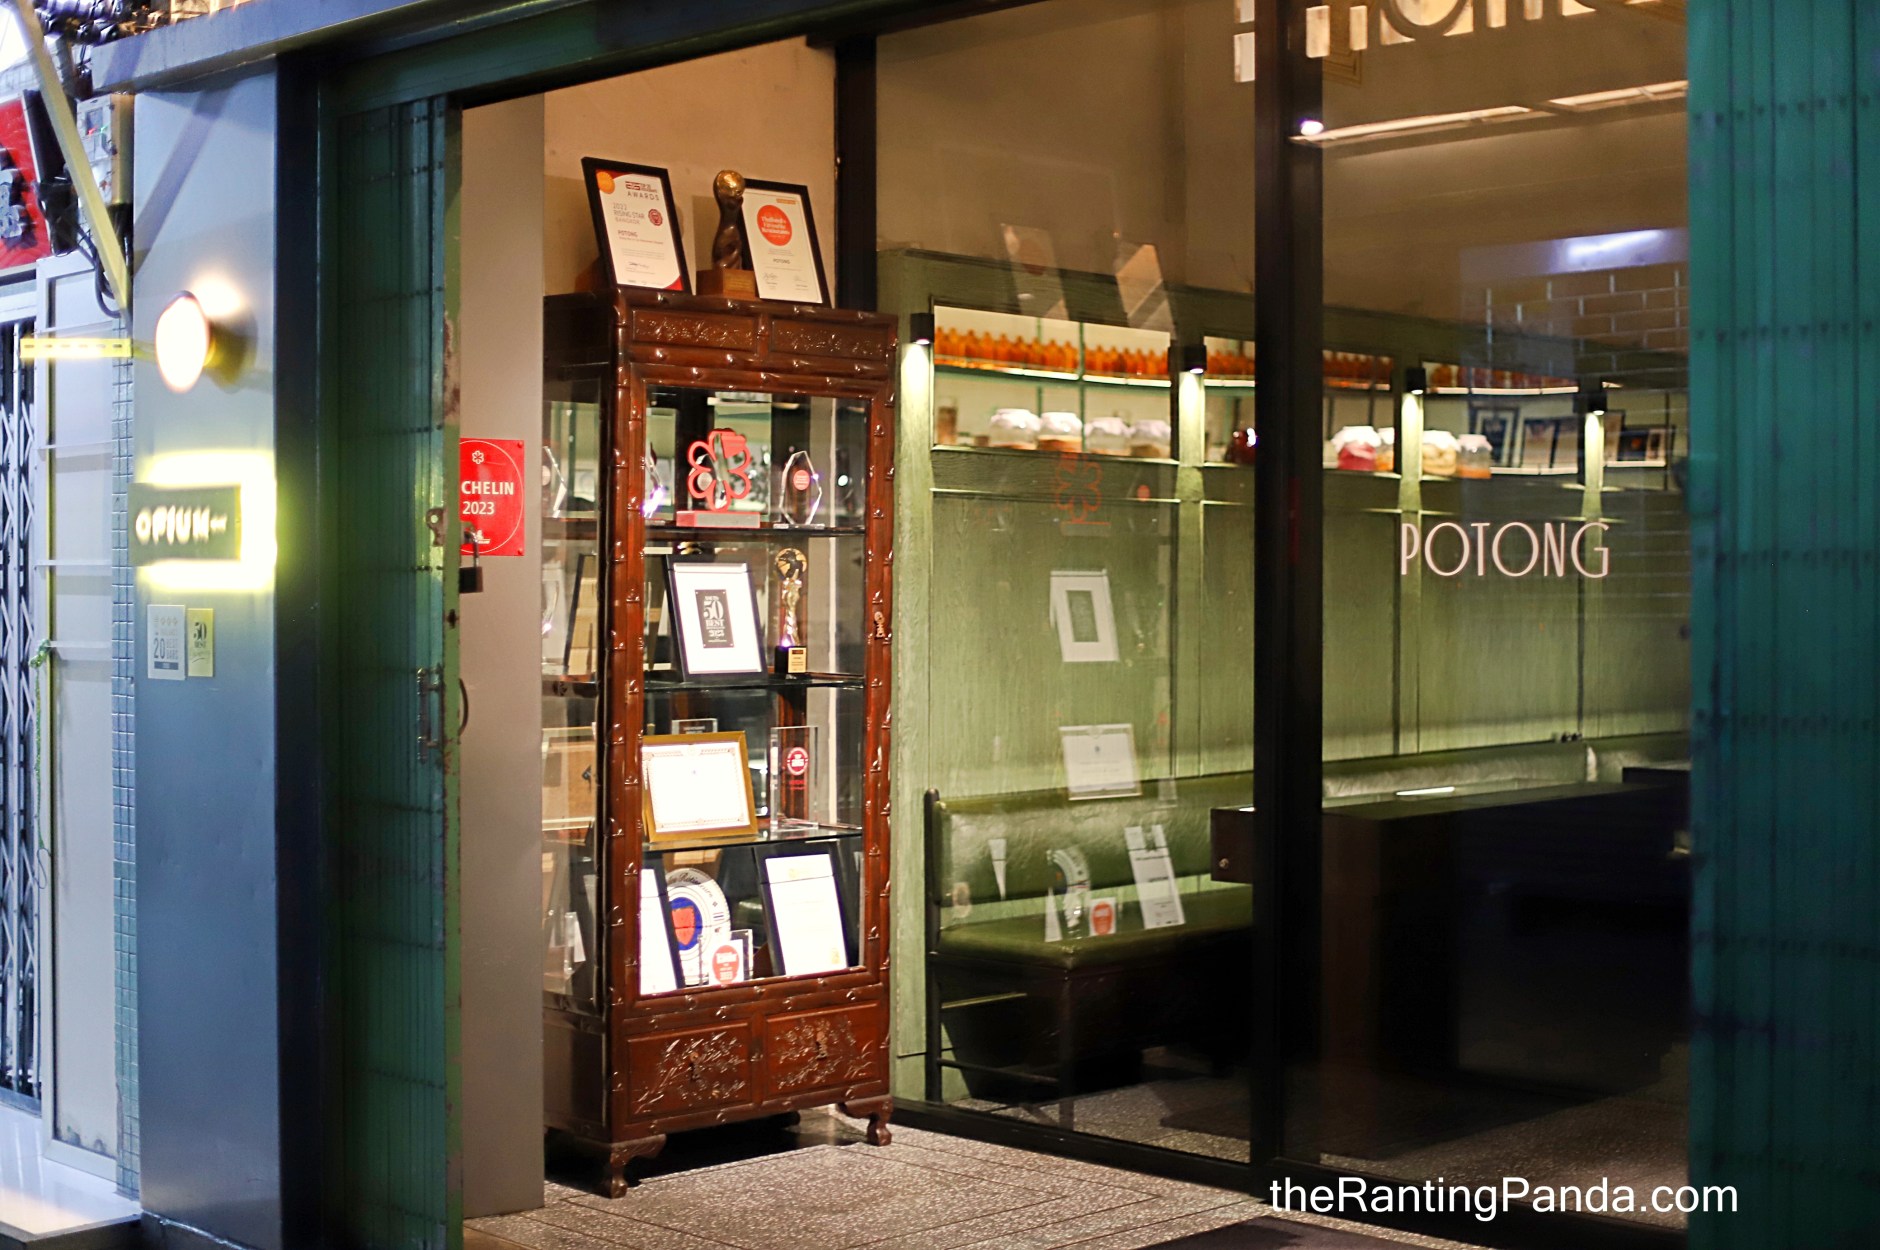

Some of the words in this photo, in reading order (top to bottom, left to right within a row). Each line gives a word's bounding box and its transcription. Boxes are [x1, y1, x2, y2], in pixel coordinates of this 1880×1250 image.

[627, 190, 660, 201] AWARDS
[461, 480, 514, 495] CHELIN
[462, 501, 495, 515] 2023
[1401, 521, 1610, 578] POTONG
[703, 600, 724, 620] 50
[193, 621, 208, 641] 50
[705, 619, 725, 627] BEST
[153, 637, 166, 660] 20
